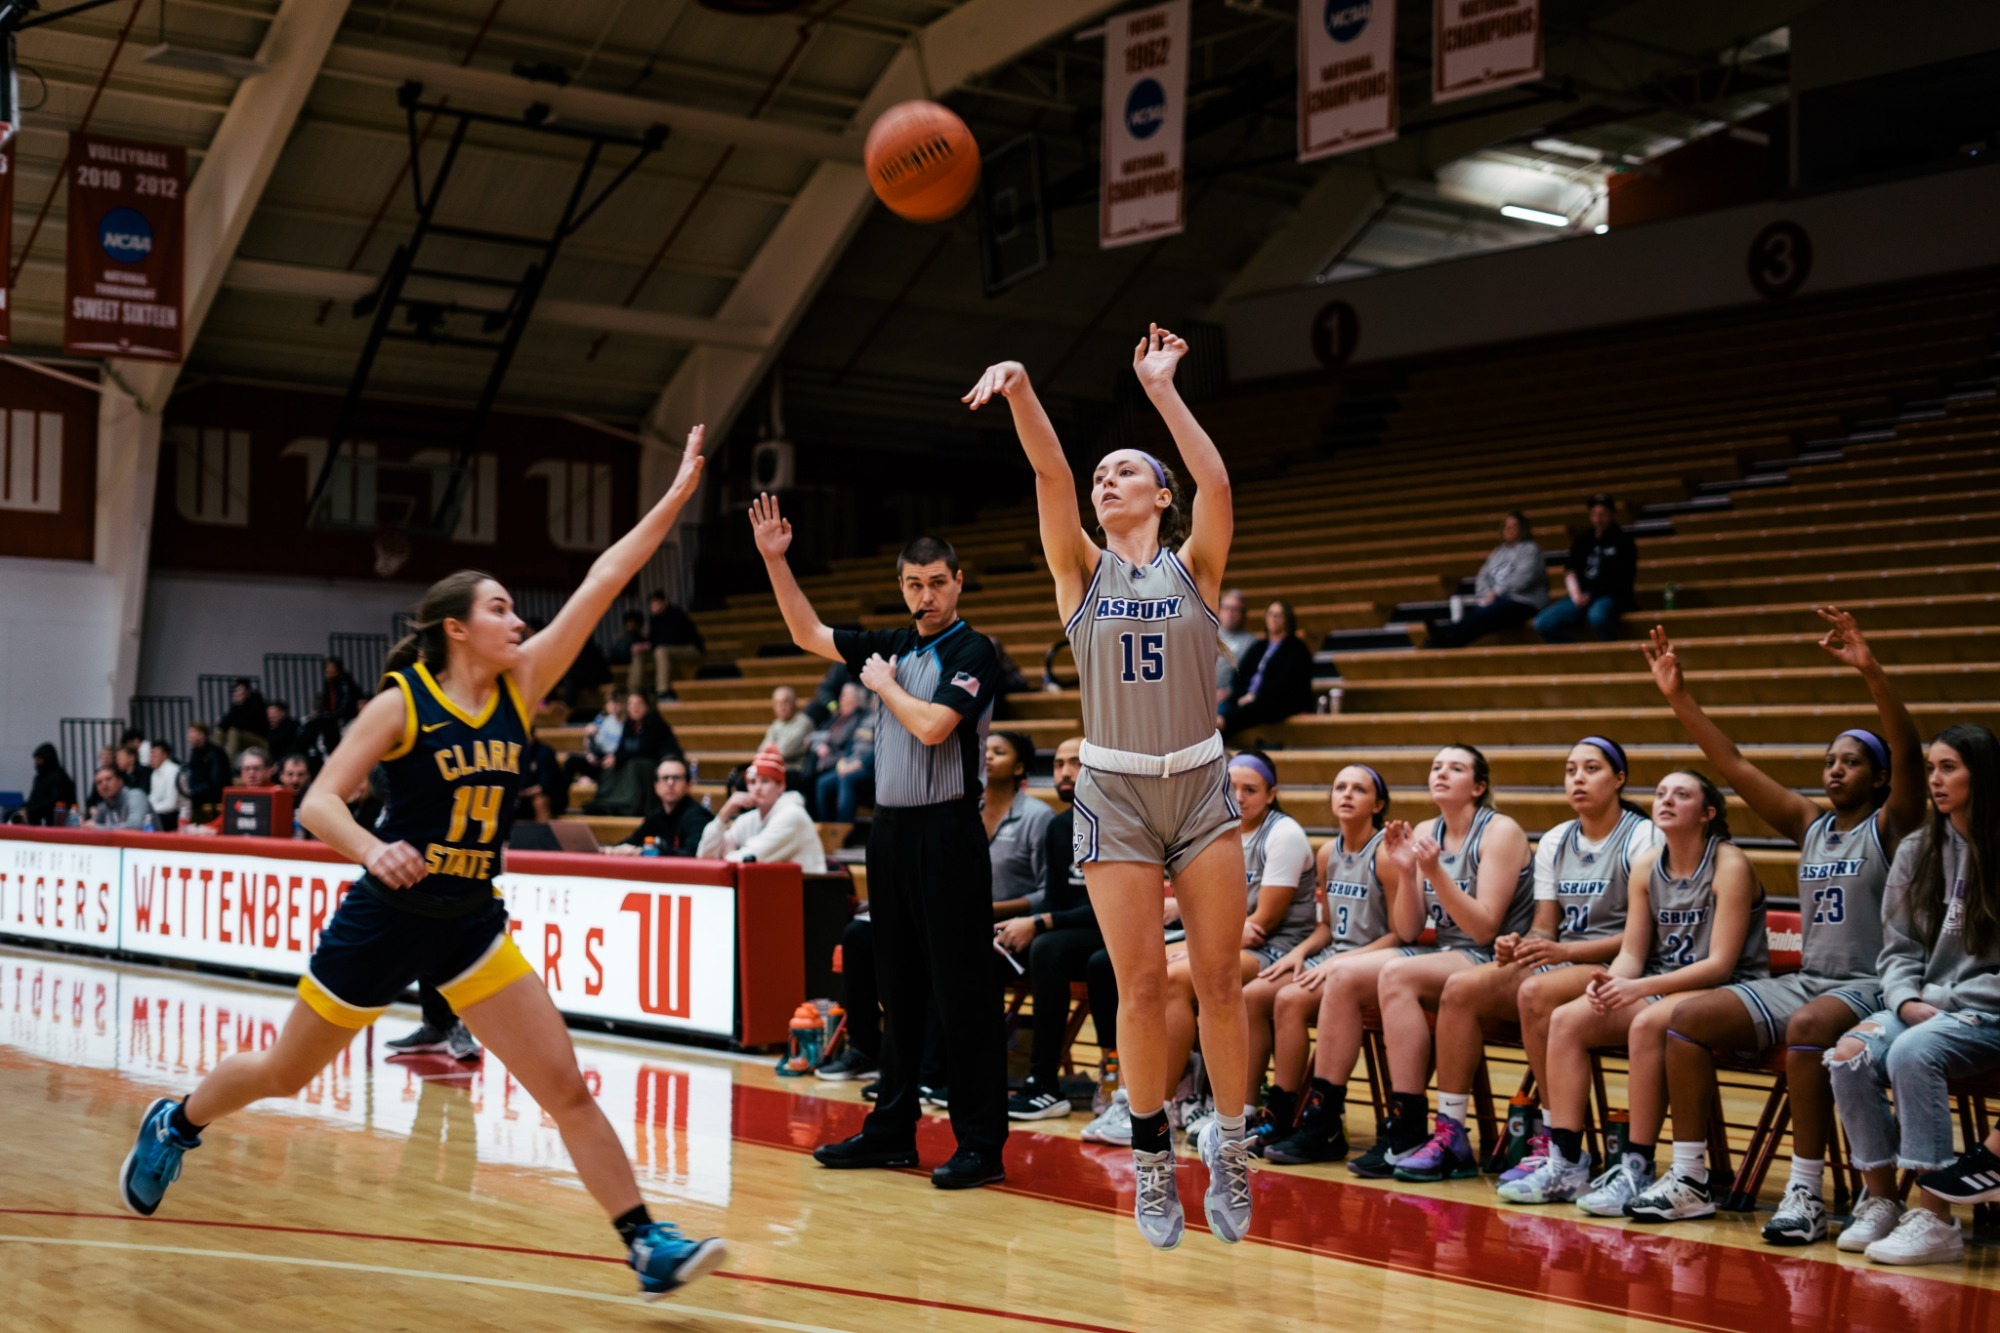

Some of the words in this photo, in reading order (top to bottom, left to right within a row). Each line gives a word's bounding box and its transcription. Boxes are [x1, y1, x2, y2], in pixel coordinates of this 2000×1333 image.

[1442, 7, 1533, 51] CHAMPIONS
[1307, 71, 1387, 114] CHAMPIONS
[87, 142, 168, 169] VOLLEYBALL
[77, 164, 121, 191] 2010
[135, 172, 179, 199] 2012
[103, 232, 152, 252] NCAA
[1762, 231, 1795, 285] 3
[72, 296, 120, 322] SWEET
[122, 301, 178, 330] SIXTEEN
[1096, 597, 1181, 620] ASBURY
[1119, 632, 1164, 683] 15
[434, 740, 522, 781] CLARK
[445, 785, 505, 844] 14
[426, 843, 495, 880] STATE
[534, 886, 570, 915] THE
[1813, 886, 1844, 923] 23
[1337, 904, 1349, 936] 3
[1667, 934, 1694, 965] 22
[1508, 1116, 1525, 1137] G
[1606, 1134, 1619, 1154] G
